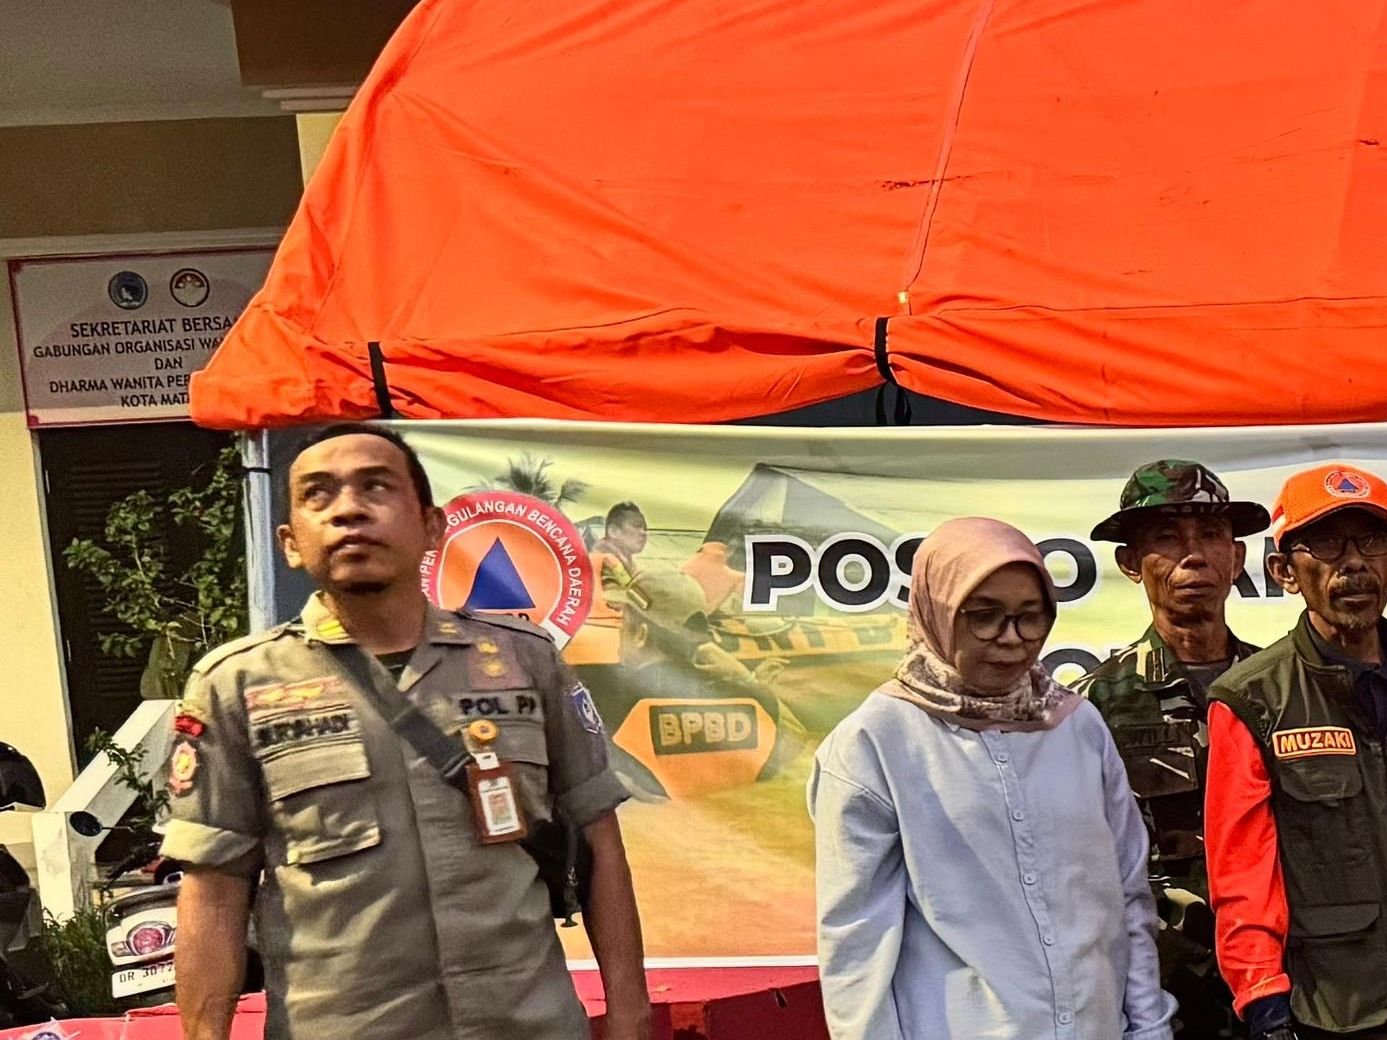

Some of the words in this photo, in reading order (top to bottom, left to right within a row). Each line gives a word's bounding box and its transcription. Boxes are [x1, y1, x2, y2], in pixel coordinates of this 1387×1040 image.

[71, 318, 176, 338] SEKRETARIAT
[34, 341, 110, 358] GABUNGAN
[115, 338, 195, 354] ORGANISASI
[155, 357, 182, 370] DAN
[50, 377, 108, 393] DHARMA
[110, 375, 163, 390] WANITA
[121, 395, 157, 408] KOTA
[528, 509, 576, 566] BENCANA
[557, 567, 582, 626] DAERAH
[459, 698, 509, 715] POL
[659, 712, 751, 746] BPBD
[1280, 731, 1351, 753] MUZAKI
